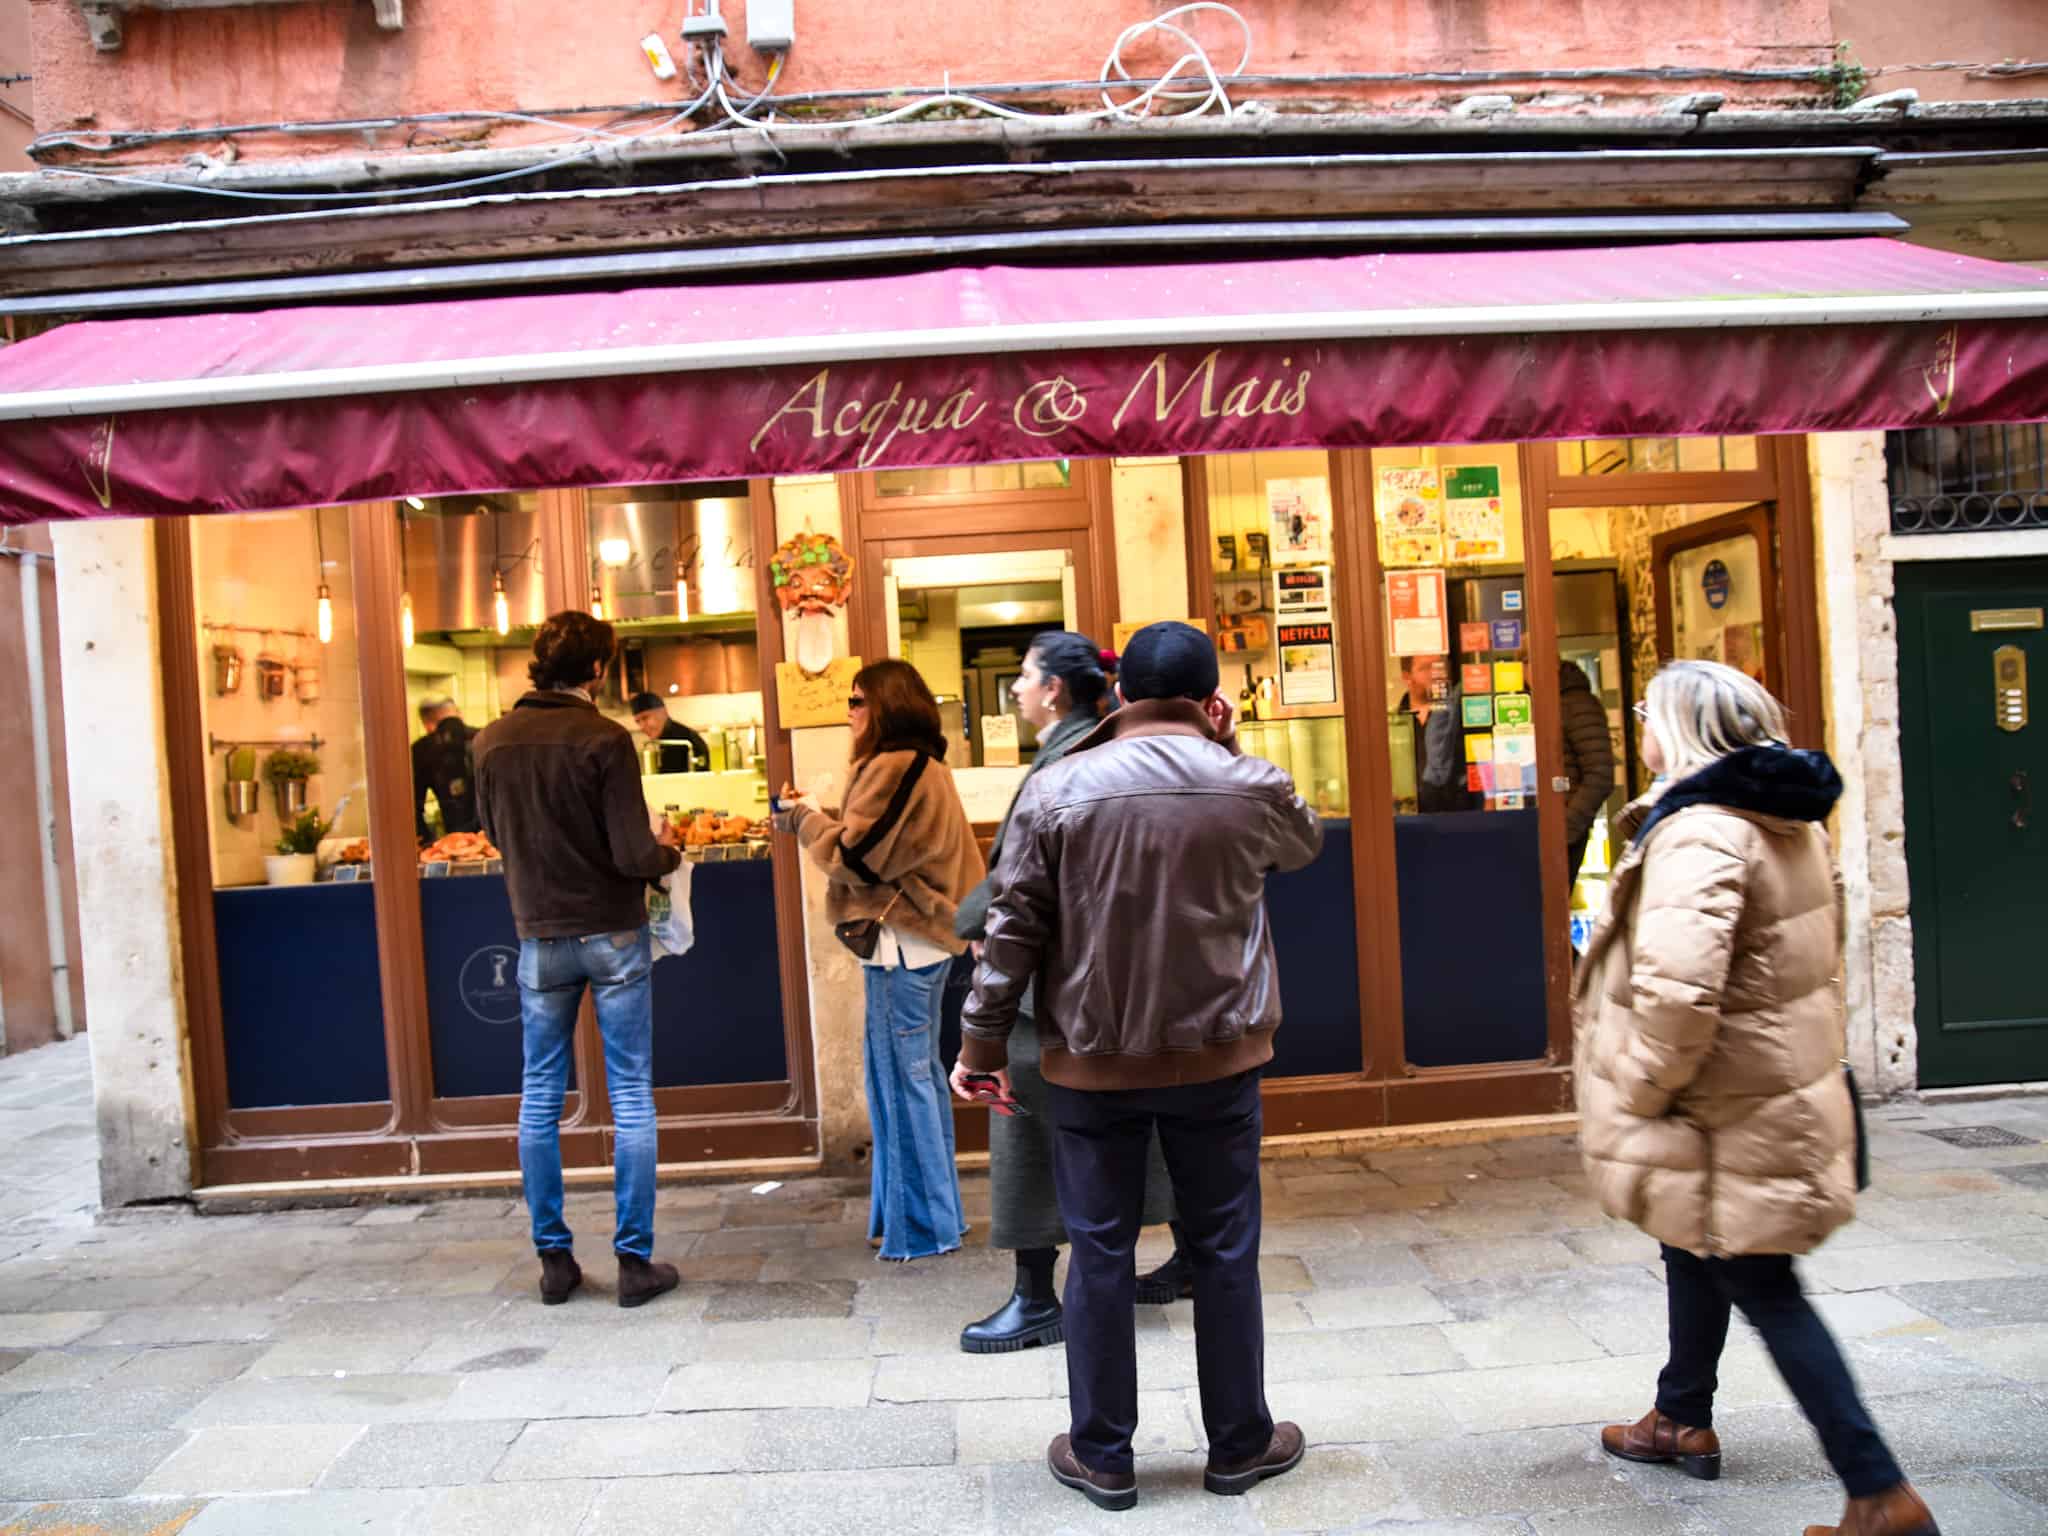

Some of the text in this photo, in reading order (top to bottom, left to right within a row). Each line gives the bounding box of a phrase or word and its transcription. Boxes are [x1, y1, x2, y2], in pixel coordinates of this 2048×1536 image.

[750, 350, 1311, 468] Acqua & Mais
[1280, 627, 1330, 643] NETFLIX
